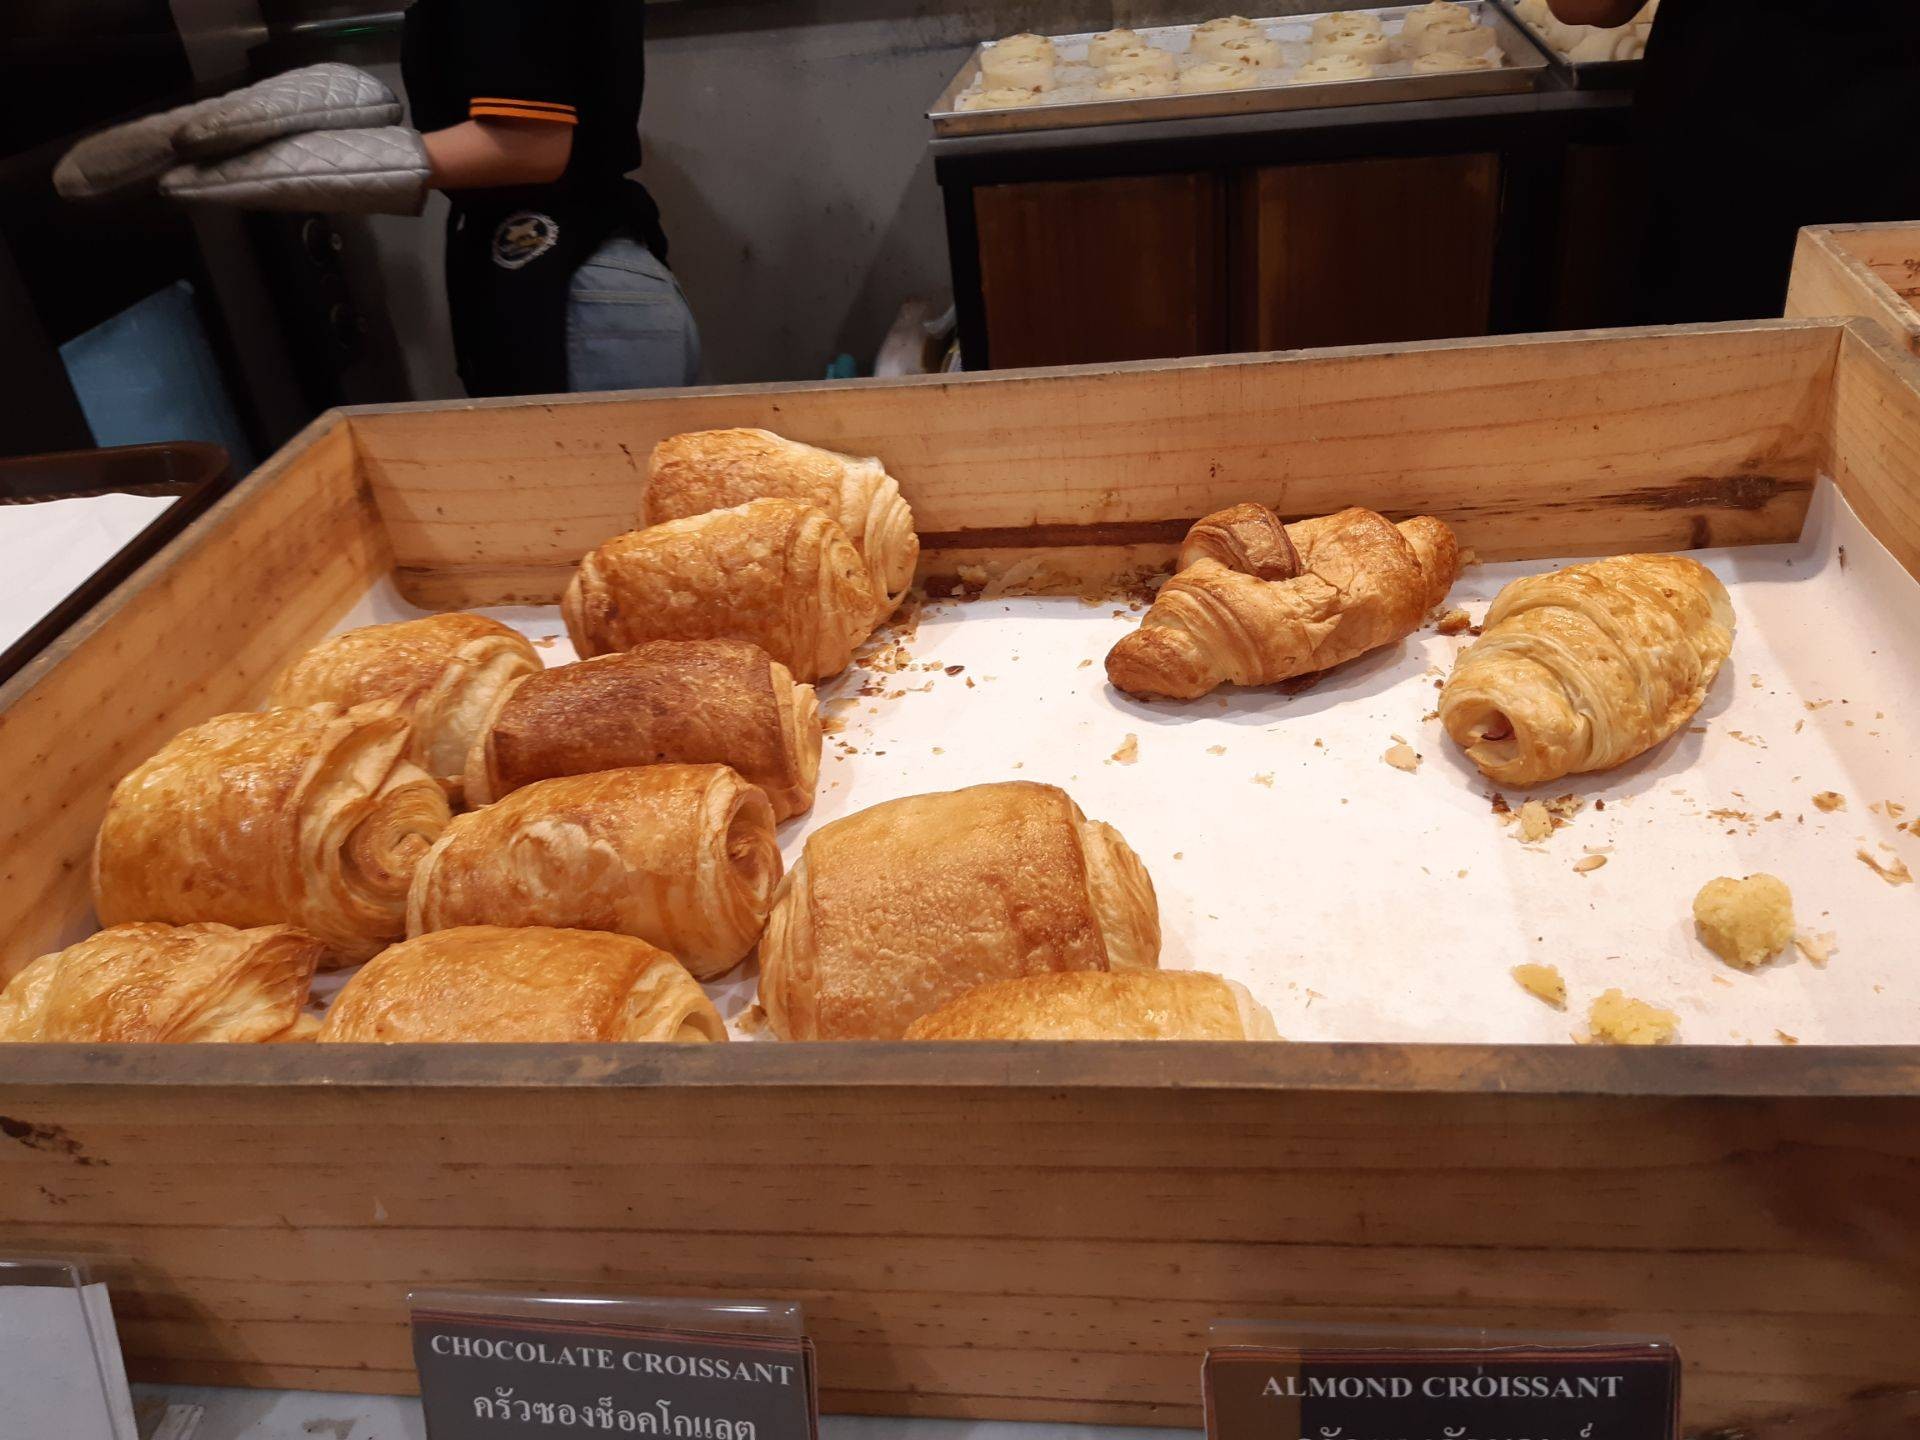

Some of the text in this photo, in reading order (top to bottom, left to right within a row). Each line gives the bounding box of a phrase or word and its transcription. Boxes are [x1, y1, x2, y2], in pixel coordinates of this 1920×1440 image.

[431, 1334, 794, 1386] CHOCOLATE CROISSANT
[1262, 1375, 1624, 1399] ALMOND CROISSANT
